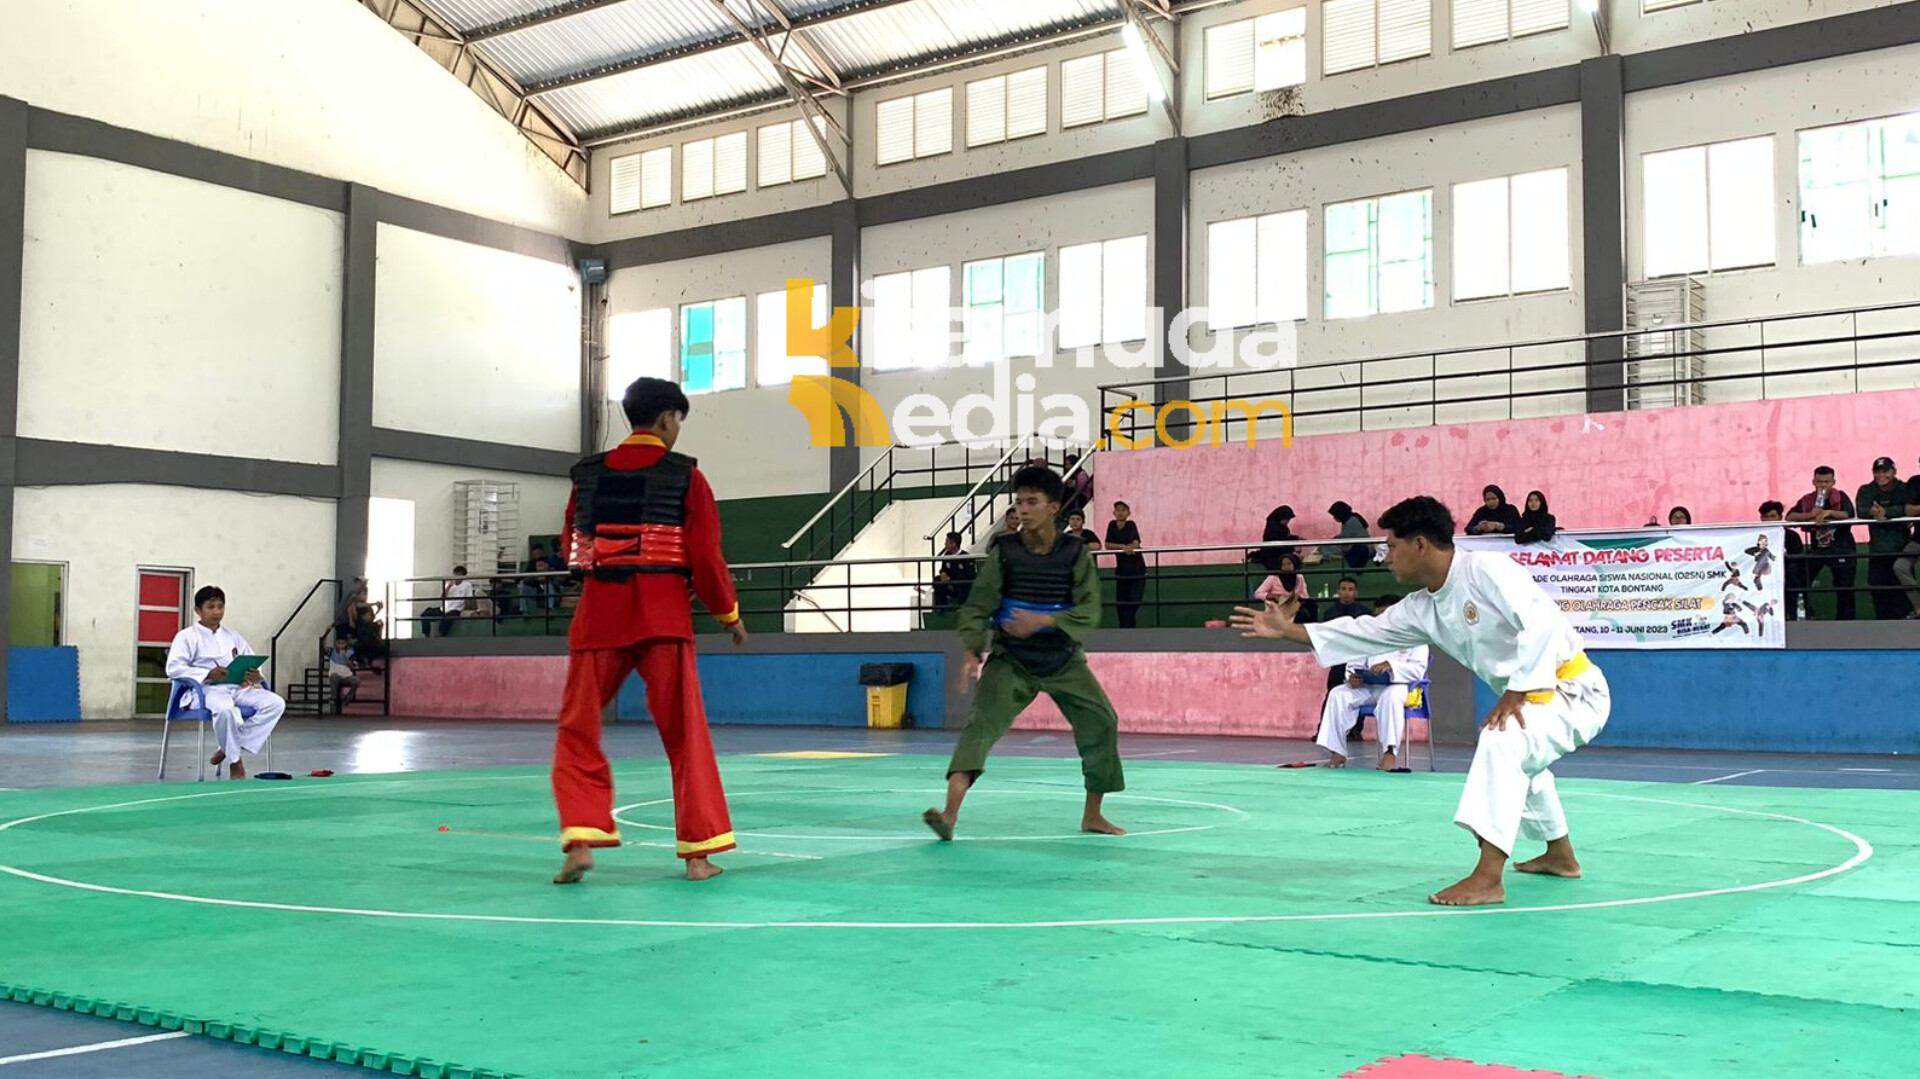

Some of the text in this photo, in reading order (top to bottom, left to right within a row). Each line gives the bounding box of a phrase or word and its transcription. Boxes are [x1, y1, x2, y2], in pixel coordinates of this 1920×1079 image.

[1583, 549, 1649, 565] DATANG
[1654, 546, 1725, 562] PESERTA
[1549, 575, 1597, 583] OLAHRAGA
[1598, 574, 1627, 582] SISWA
[1628, 573, 1673, 581] NASIONAL
[1706, 570, 1727, 579] SMK
[1561, 584, 1664, 594] TINGKAT KOTA BONTANG
[1572, 600, 1628, 612] OLAHRAGA
[1630, 598, 1673, 611] PENCAK
[1675, 597, 1703, 610] SILAT
[1646, 625, 1668, 634] 2023
